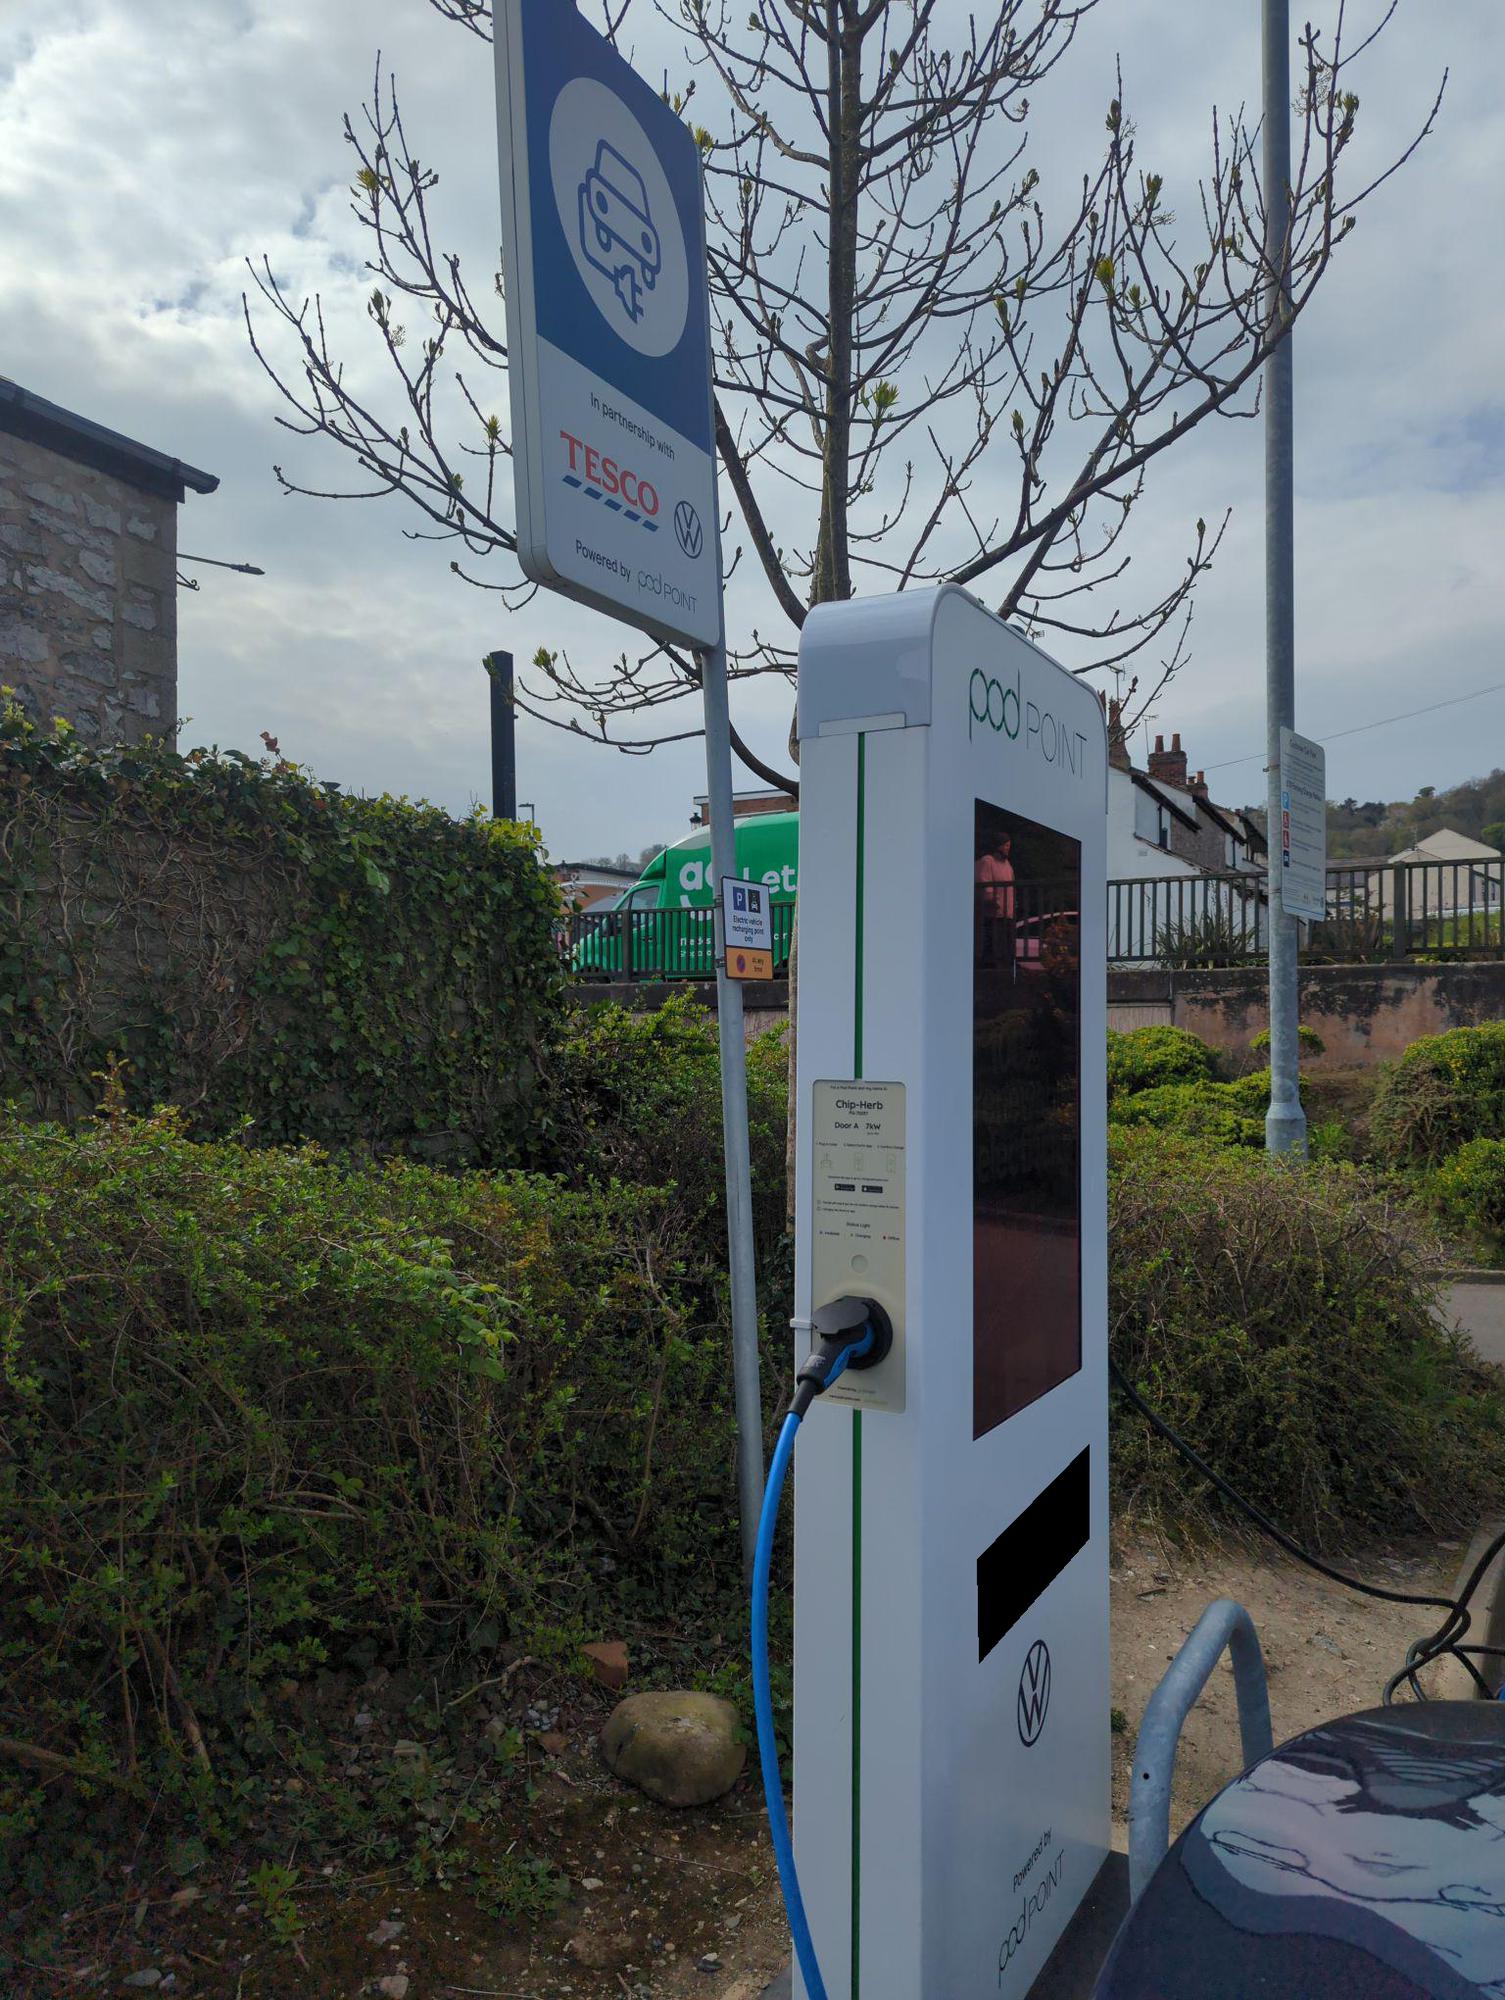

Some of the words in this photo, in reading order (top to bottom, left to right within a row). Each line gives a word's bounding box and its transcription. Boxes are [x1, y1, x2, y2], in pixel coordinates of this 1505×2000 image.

[590, 392, 600, 410] In
[602, 402, 656, 449] partnership
[656, 438, 675, 461] with
[560, 430, 659, 516] TESCO
[576, 539, 618, 573] Powered
[620, 562, 631, 583] by
[638, 570, 662, 595] pod
[663, 583, 697, 614] POINT
[969, 667, 1021, 745] pod
[1027, 701, 1087, 779] POINT
[733, 915, 748, 925] Electric
[834, 1121, 851, 1130] Door
[853, 1122, 859, 1130] A
[865, 1122, 881, 1131] 7kW
[835, 1099, 884, 1111] Chip-Herb
[1013, 1837, 1043, 1893] Powered
[1043, 1826, 1052, 1847] by
[998, 1896, 1026, 1989] pod
[1028, 1848, 1064, 1931] POINT
